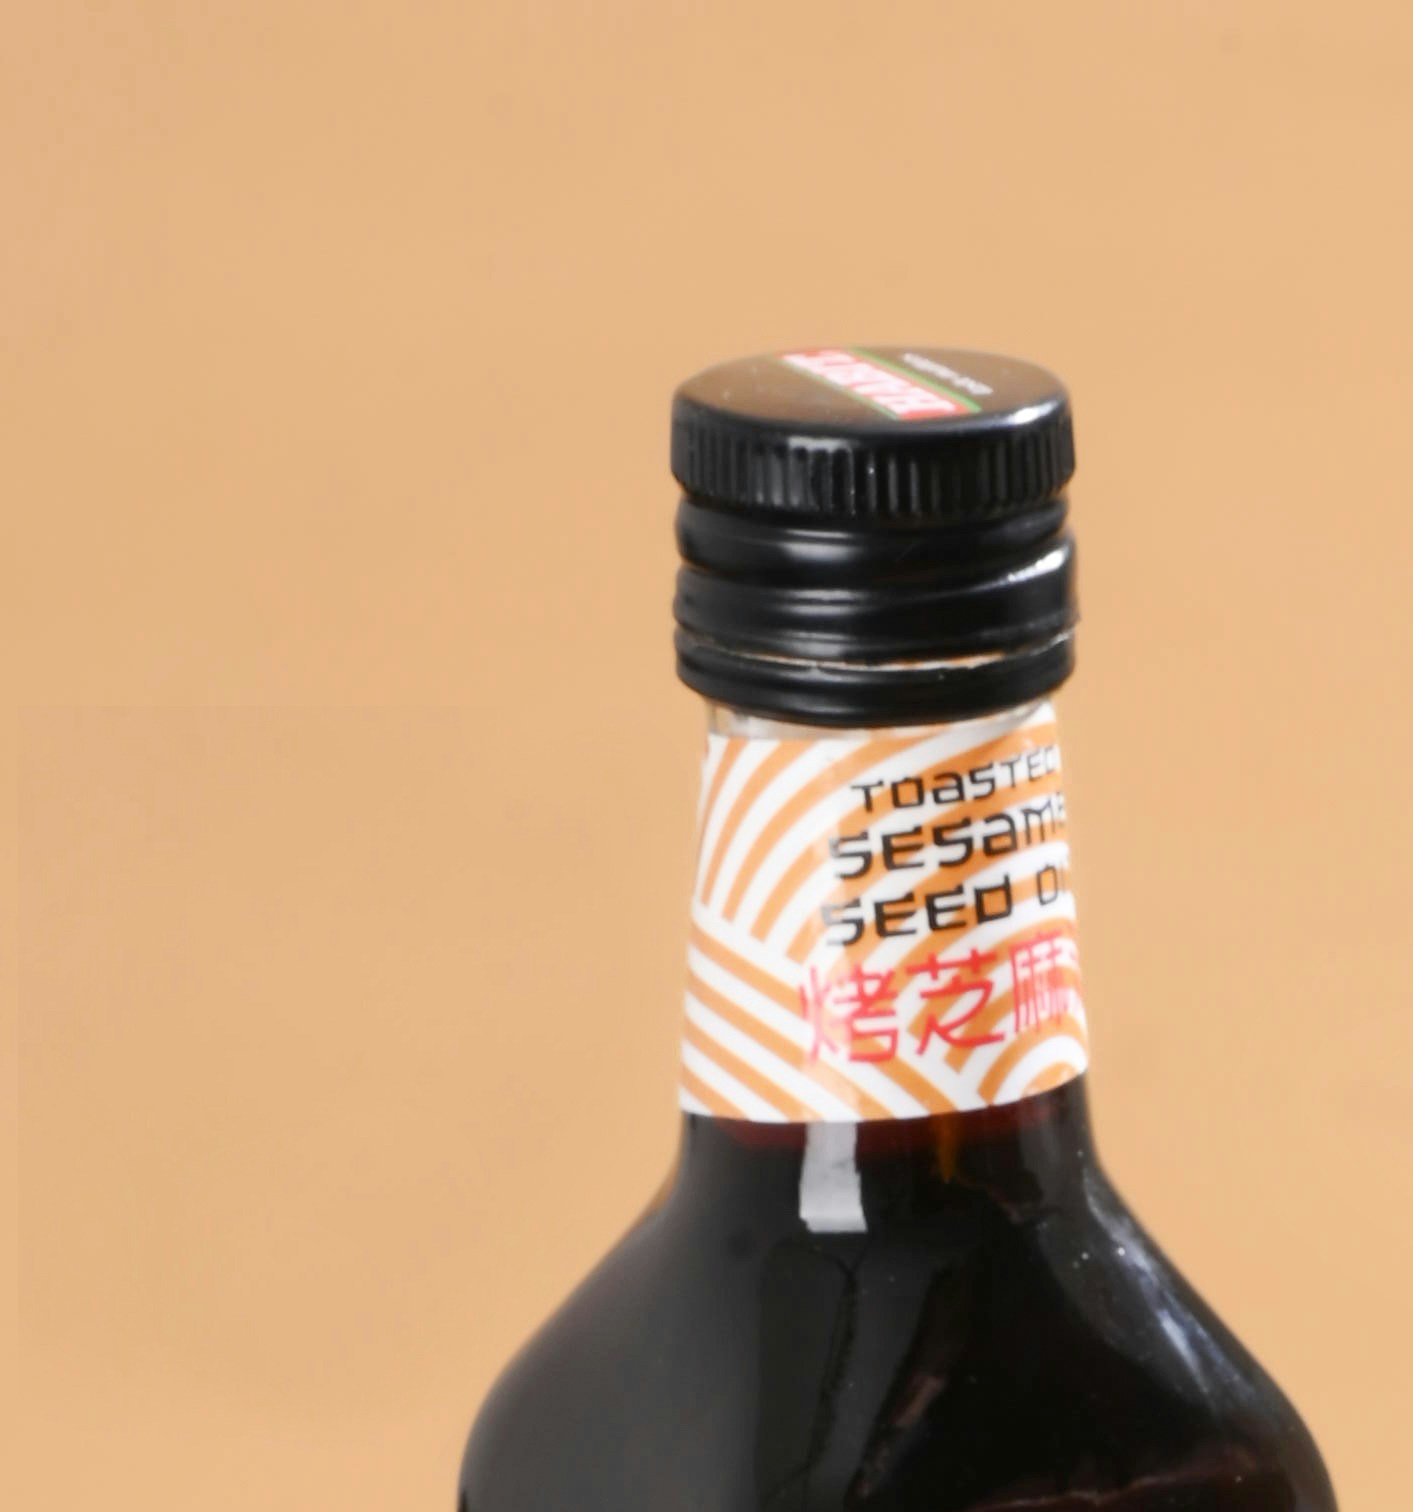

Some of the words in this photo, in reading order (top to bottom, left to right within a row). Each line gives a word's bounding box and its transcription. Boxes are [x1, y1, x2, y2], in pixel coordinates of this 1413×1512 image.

[821, 873, 1013, 945] SEED
[800, 926, 1078, 1064] 烤芝麻
